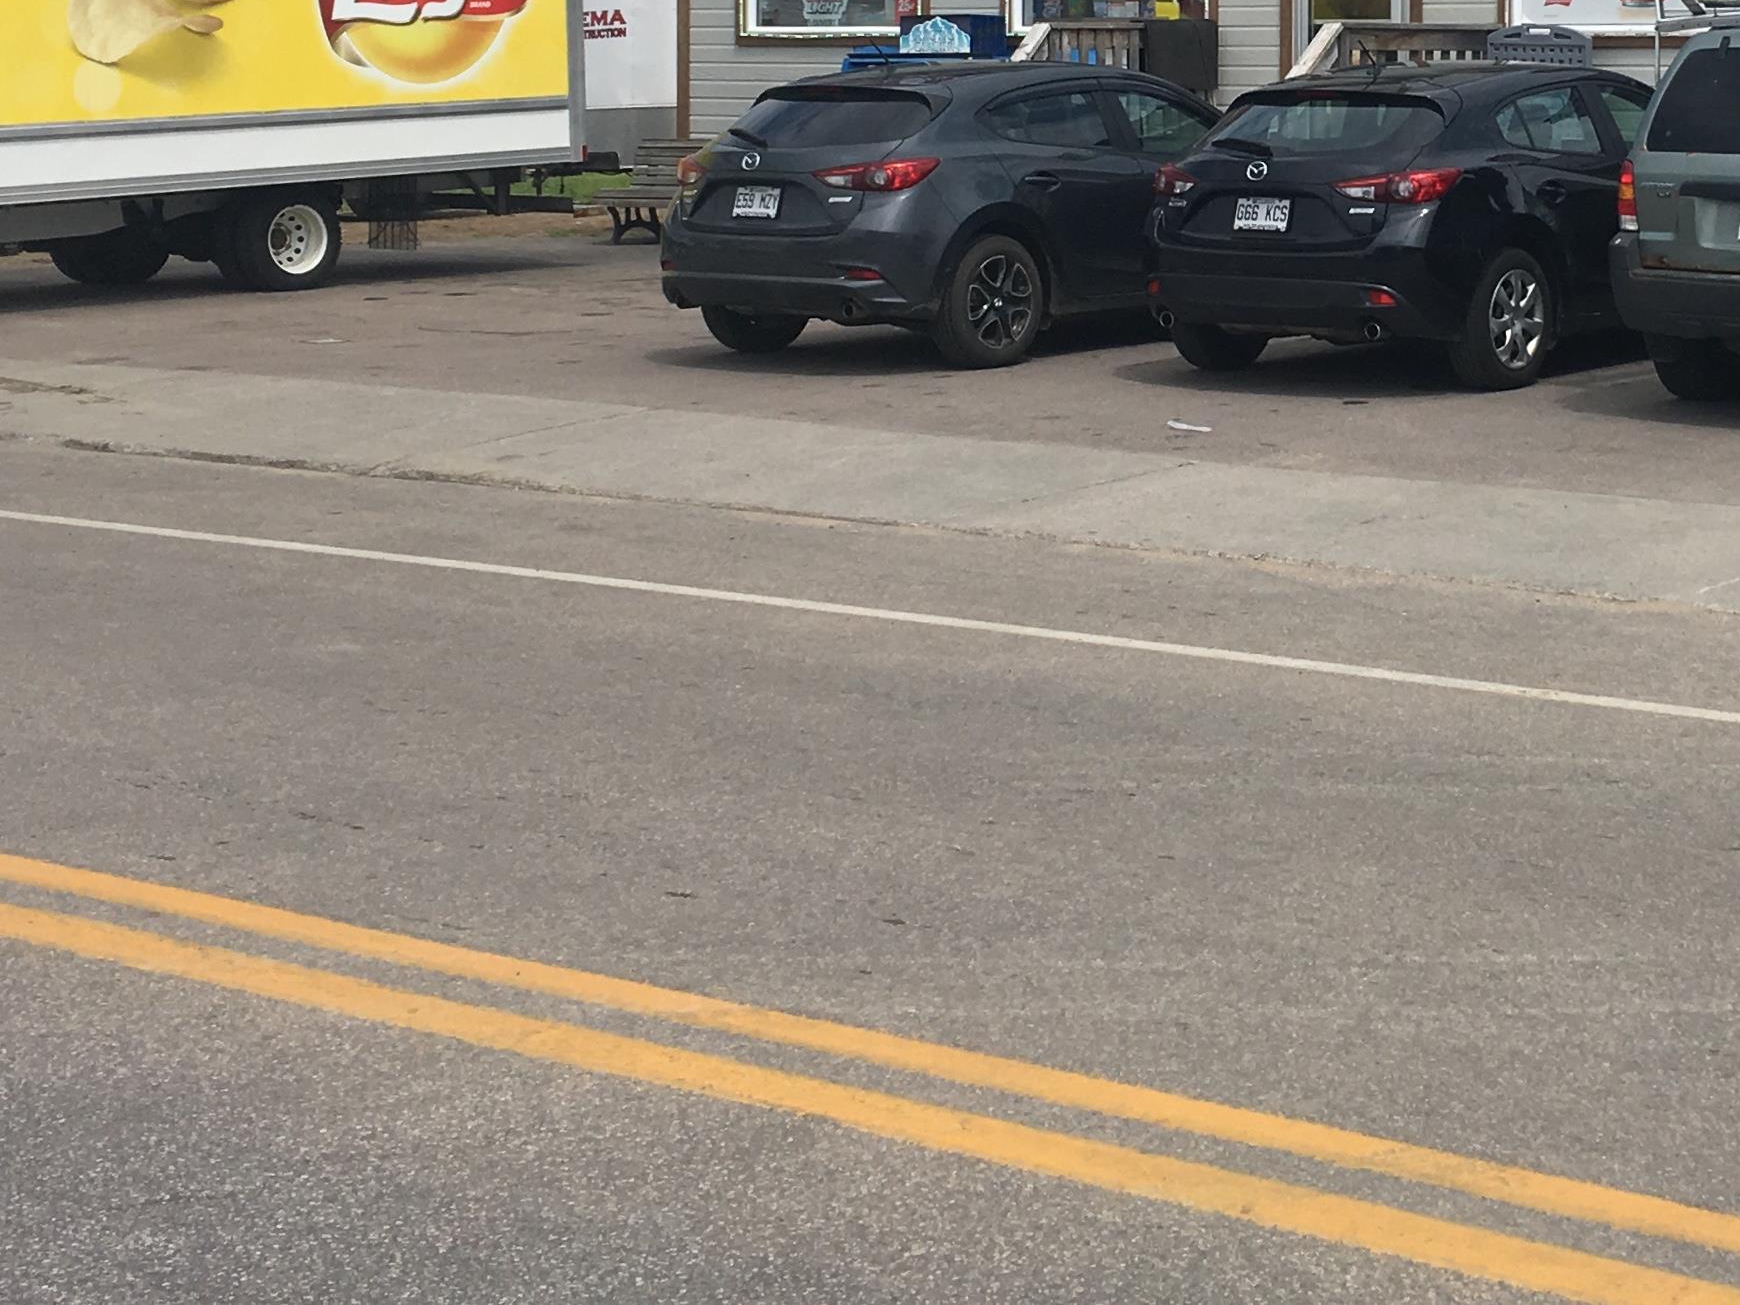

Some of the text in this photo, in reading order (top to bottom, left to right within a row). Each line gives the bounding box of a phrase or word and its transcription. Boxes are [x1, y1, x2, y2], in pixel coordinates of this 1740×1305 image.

[806, 1, 842, 15] LIGHT
[1237, 205, 1288, 223] G66 KCS
